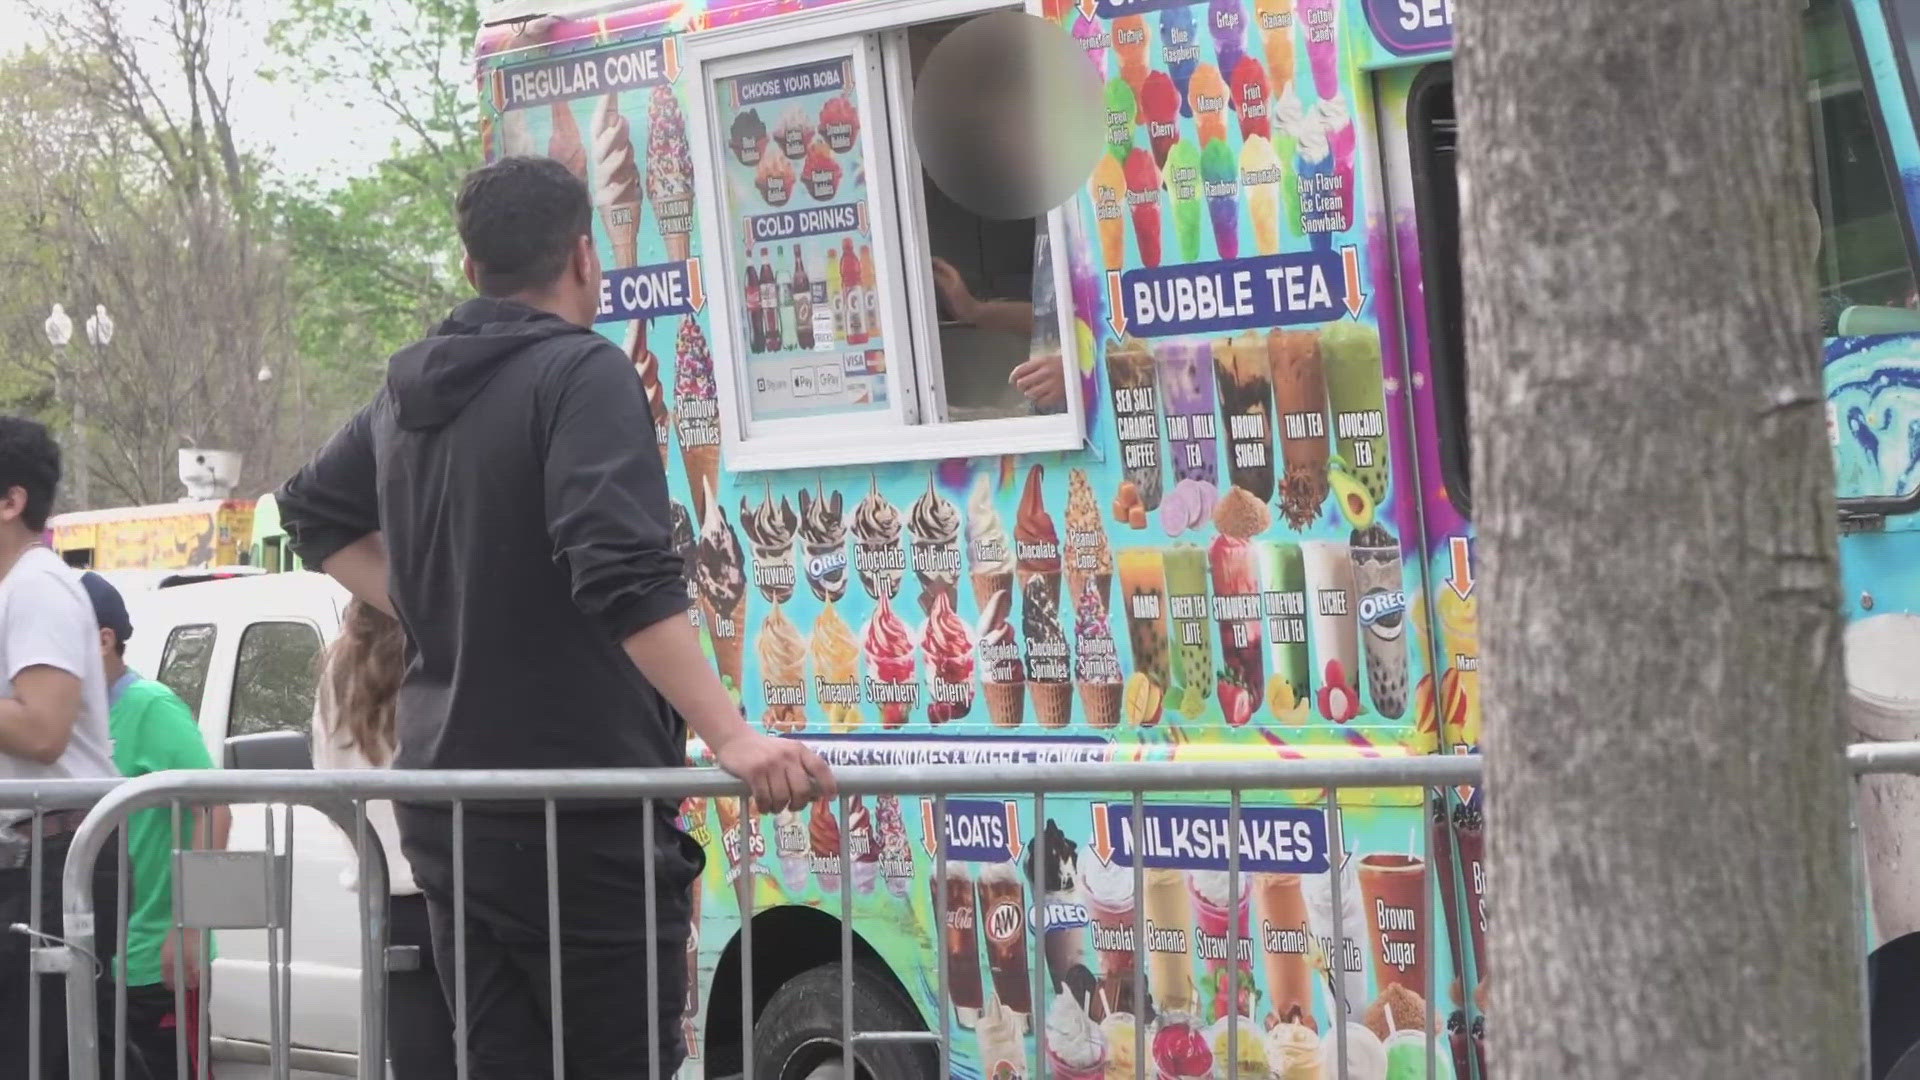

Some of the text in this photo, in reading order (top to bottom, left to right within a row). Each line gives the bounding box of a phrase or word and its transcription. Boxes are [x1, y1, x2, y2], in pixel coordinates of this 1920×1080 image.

[1216, 11, 1239, 30] Grape
[1262, 12, 1292, 29] Banana
[1307, 9, 1334, 25] Cotton
[1118, 28, 1144, 45] Orange
[1171, 27, 1188, 44] Blue
[1310, 26, 1334, 43] Candy
[1163, 46, 1200, 64] Raspberry
[511, 49, 659, 103] REGULAR CONE
[742, 70, 840, 99] CHOOSE YOUR BOBA
[1243, 83, 1261, 99] Fruit
[1197, 96, 1223, 113] Mango
[1242, 102, 1266, 121] Punch
[1151, 121, 1175, 138] Cherry
[1241, 165, 1281, 185] Lemonade
[1298, 173, 1342, 193] Any Flavor
[1205, 181, 1237, 196] Rainbow
[1301, 193, 1343, 212] Ice Cream
[756, 207, 855, 238] COLD DRINKS
[1301, 214, 1346, 233] Snowballs
[620, 271, 683, 311] CONE
[1133, 265, 1333, 324] BUBBLE TEA
[846, 353, 864, 367] VISA
[677, 395, 716, 419] Rainbow
[1116, 387, 1153, 412] SEA SALT
[679, 422, 720, 450] Sprinkles
[1118, 415, 1158, 441] CARAMEL
[1166, 414, 1216, 440] TARO MILK
[1230, 414, 1264, 439] BROWN
[1285, 413, 1324, 439] THAI TEA
[1339, 411, 1383, 438] AVOCADO
[1126, 443, 1156, 468] COFFEE
[1186, 443, 1202, 468] TEA
[1235, 443, 1266, 467] SUGAR
[1354, 441, 1373, 466] TEA
[975, 540, 1004, 561] Vanilla
[1017, 540, 1056, 560] Chocolate
[1070, 530, 1098, 549] Peanut
[810, 554, 846, 577] OREO
[855, 545, 905, 572] Chocolate
[910, 544, 961, 573] Hot Fudge
[754, 561, 795, 586] Brownie
[872, 573, 893, 597] Nut
[1132, 595, 1159, 618] MANGO
[1171, 596, 1207, 618] GREEN TEA
[1213, 595, 1261, 620] STRAWBERRY
[1265, 592, 1304, 615] HONEYDEW
[1319, 591, 1347, 615] LYCHEE
[1360, 592, 1405, 620] OREO
[715, 613, 735, 637] Oreo
[1182, 623, 1201, 645] LATTE
[1232, 624, 1248, 648] TEA
[1271, 618, 1305, 643] MILK TEA
[1027, 638, 1066, 656] Chocolate
[1078, 637, 1113, 654] Rainbow
[991, 663, 1012, 680] Swirl
[1030, 660, 1067, 680] Sprinkles
[1079, 657, 1117, 678] Sprinkles
[764, 681, 805, 705] Caramel
[816, 677, 860, 708] Pineapple
[866, 677, 919, 708] Strawberry
[934, 677, 970, 707] Cherry
[779, 827, 804, 850] Vanilla
[1121, 816, 1313, 862] MILKSHAKES
[809, 852, 841, 874] Chocolat
[879, 853, 914, 881] Sprinkles
[1377, 898, 1415, 931] Brown
[1092, 921, 1134, 951] Chocolat
[1147, 921, 1186, 952] Banana
[1197, 928, 1254, 967] Strawrry
[1263, 921, 1308, 953] Caramel
[1322, 938, 1361, 971] Vailla
[1381, 934, 1415, 971] Sugar
